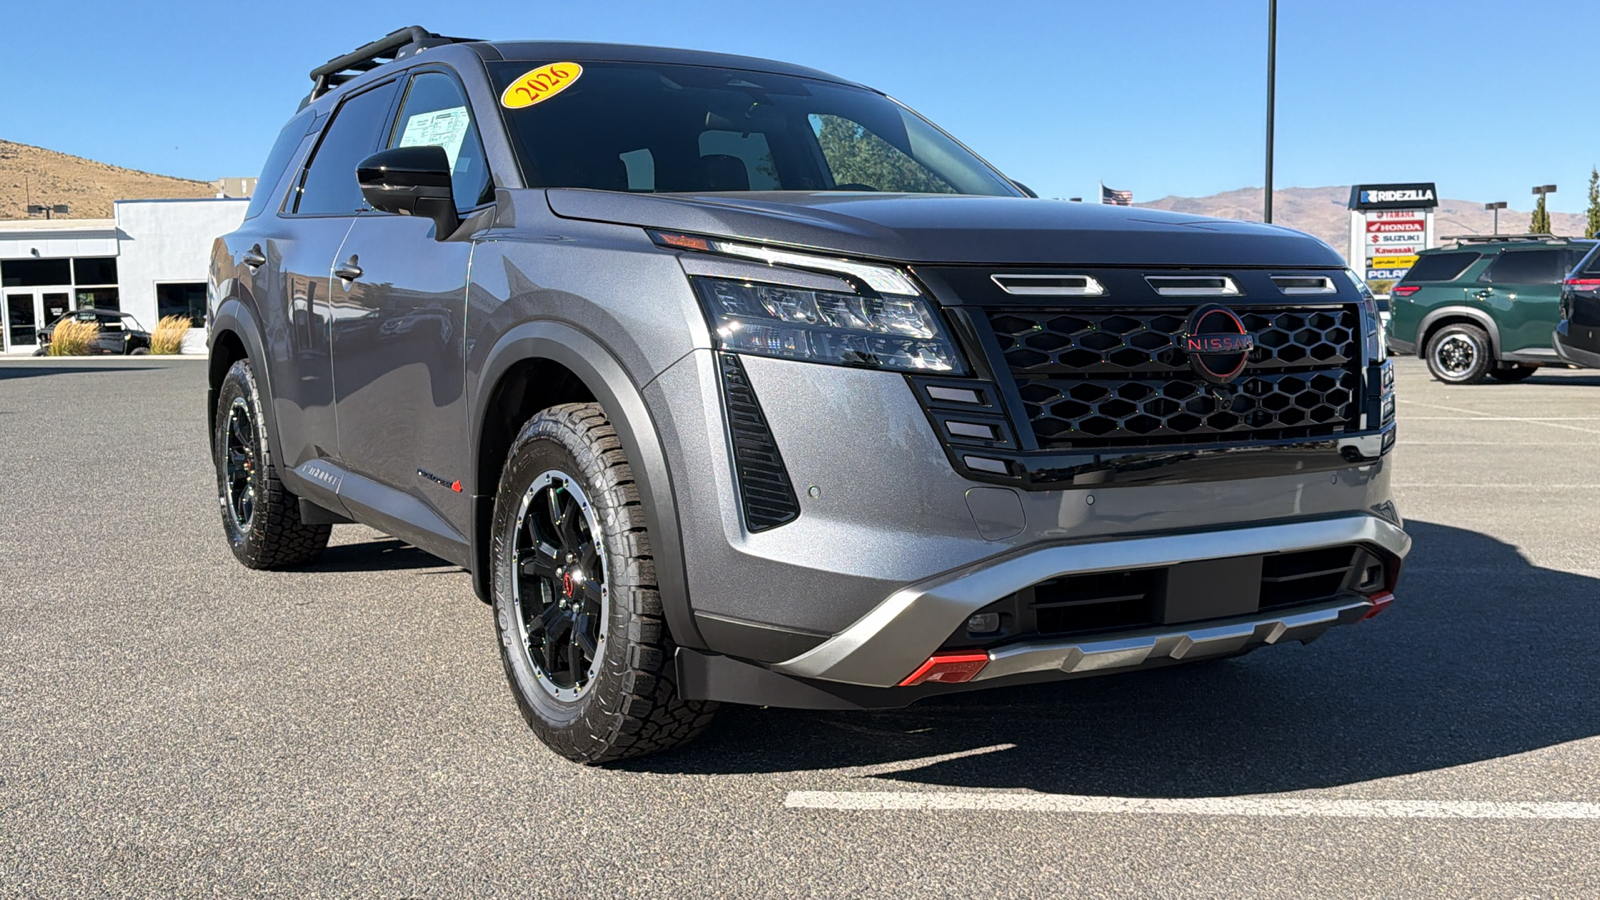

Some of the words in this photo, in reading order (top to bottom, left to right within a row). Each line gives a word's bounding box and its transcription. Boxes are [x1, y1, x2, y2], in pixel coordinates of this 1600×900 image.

[515, 66, 570, 102] 2026
[1378, 190, 1433, 201] RIDEZILLA
[1188, 337, 1253, 350] NISSAN
